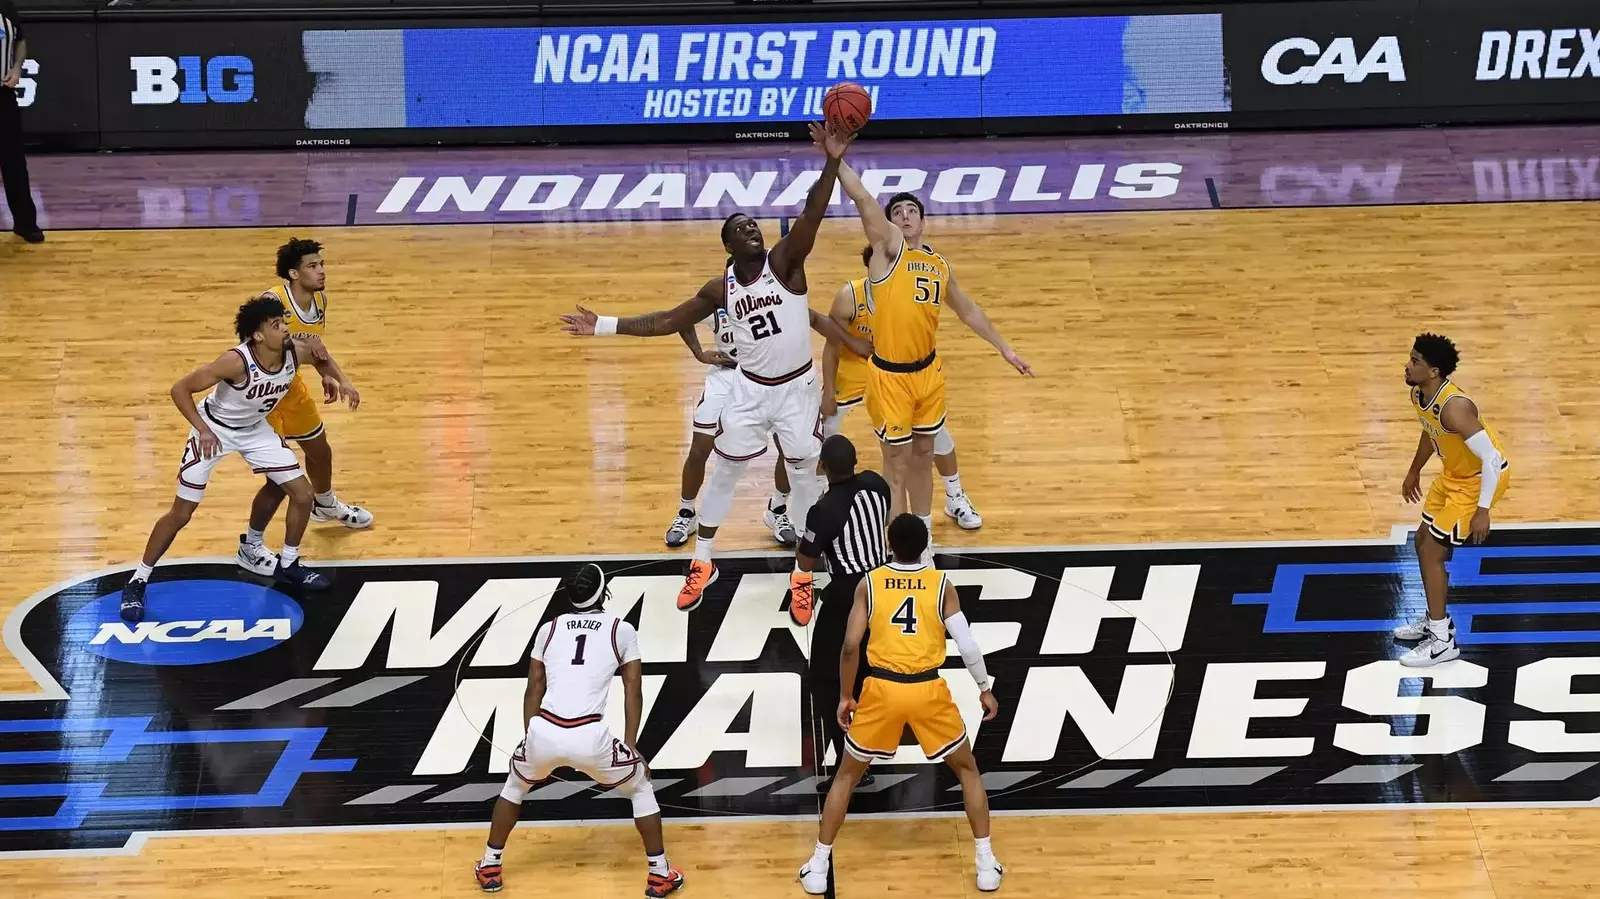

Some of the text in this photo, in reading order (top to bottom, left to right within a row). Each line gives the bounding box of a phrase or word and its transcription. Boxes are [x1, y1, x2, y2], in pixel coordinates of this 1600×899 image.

[533, 27, 997, 84] NCAA FIRST ROUND
[1260, 36, 1407, 85] CAA
[643, 86, 880, 118] HOSTED BY IUI
[735, 131, 790, 139] DAKTRONICS
[376, 162, 1183, 213] INDIANAPOLIS
[735, 290, 783, 320] Illinois
[914, 276, 941, 305] 51
[748, 310, 782, 340] 21
[884, 577, 927, 591] BELL
[566, 619, 602, 632] FRAZIER
[889, 595, 919, 635] 4
[90, 617, 292, 645] NCAA
[571, 633, 587, 665] 1
